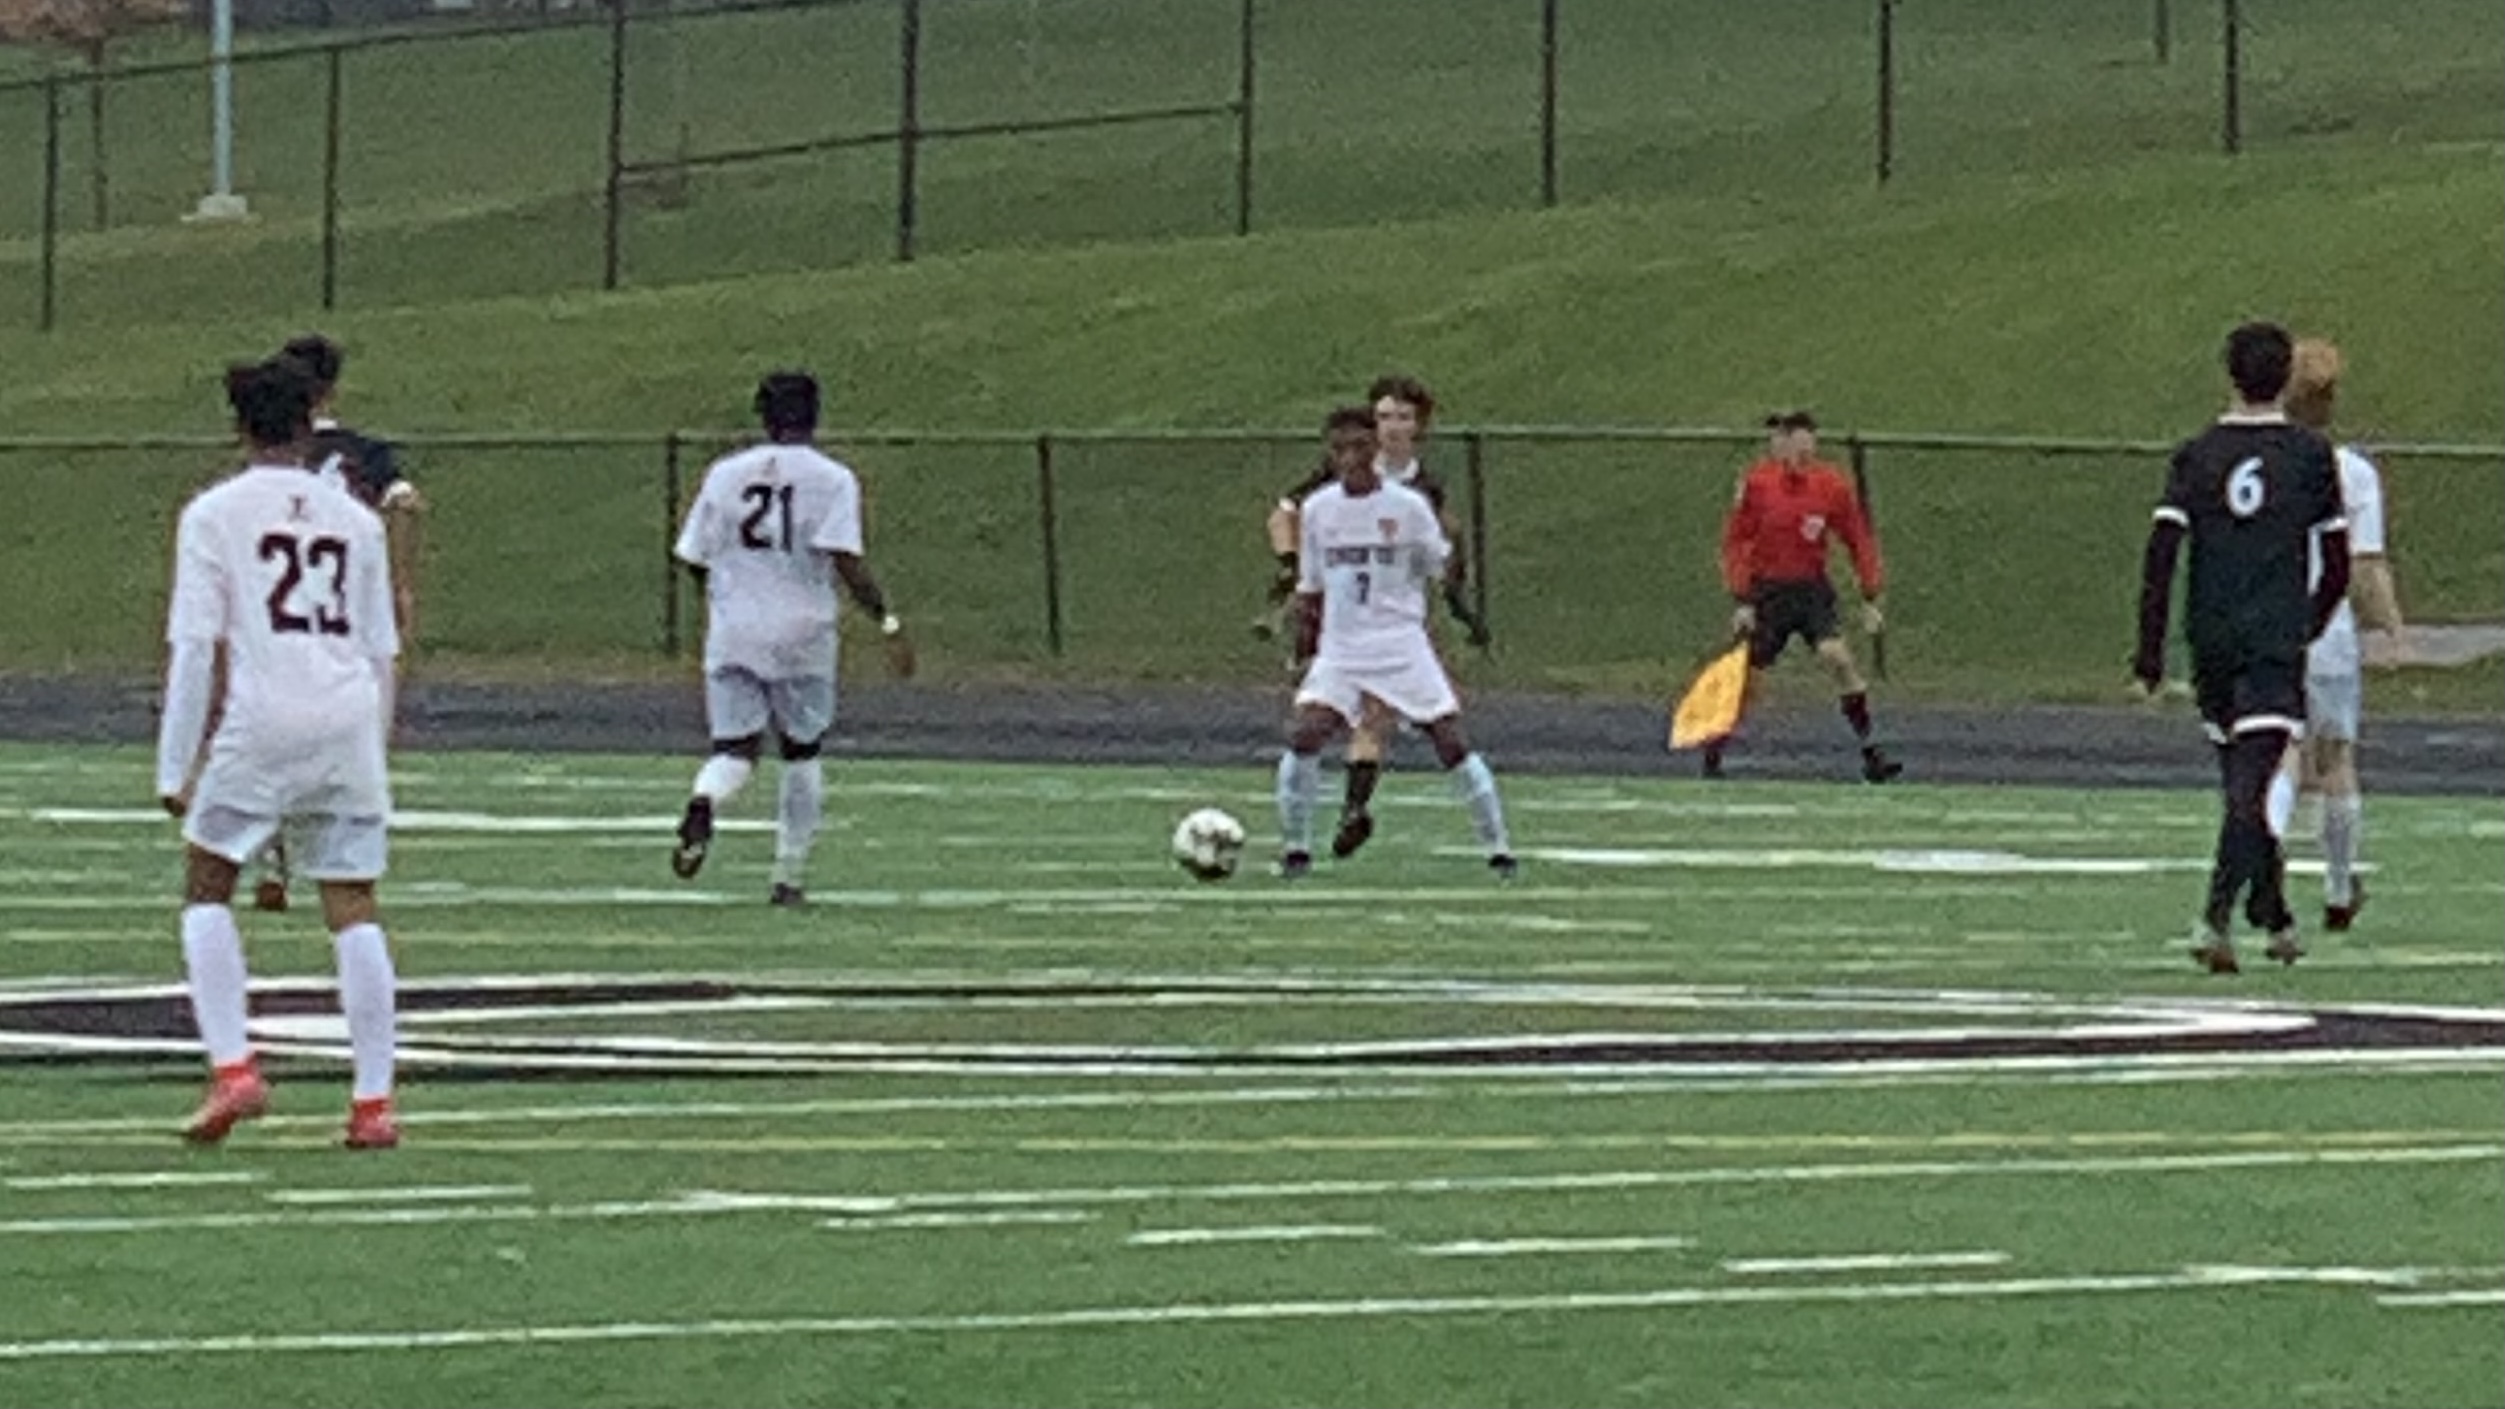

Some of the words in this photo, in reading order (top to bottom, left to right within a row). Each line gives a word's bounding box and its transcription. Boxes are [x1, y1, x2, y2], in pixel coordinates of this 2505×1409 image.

[742, 484, 793, 554] 21
[2227, 456, 2264, 518] 6
[260, 534, 350, 635] 23
